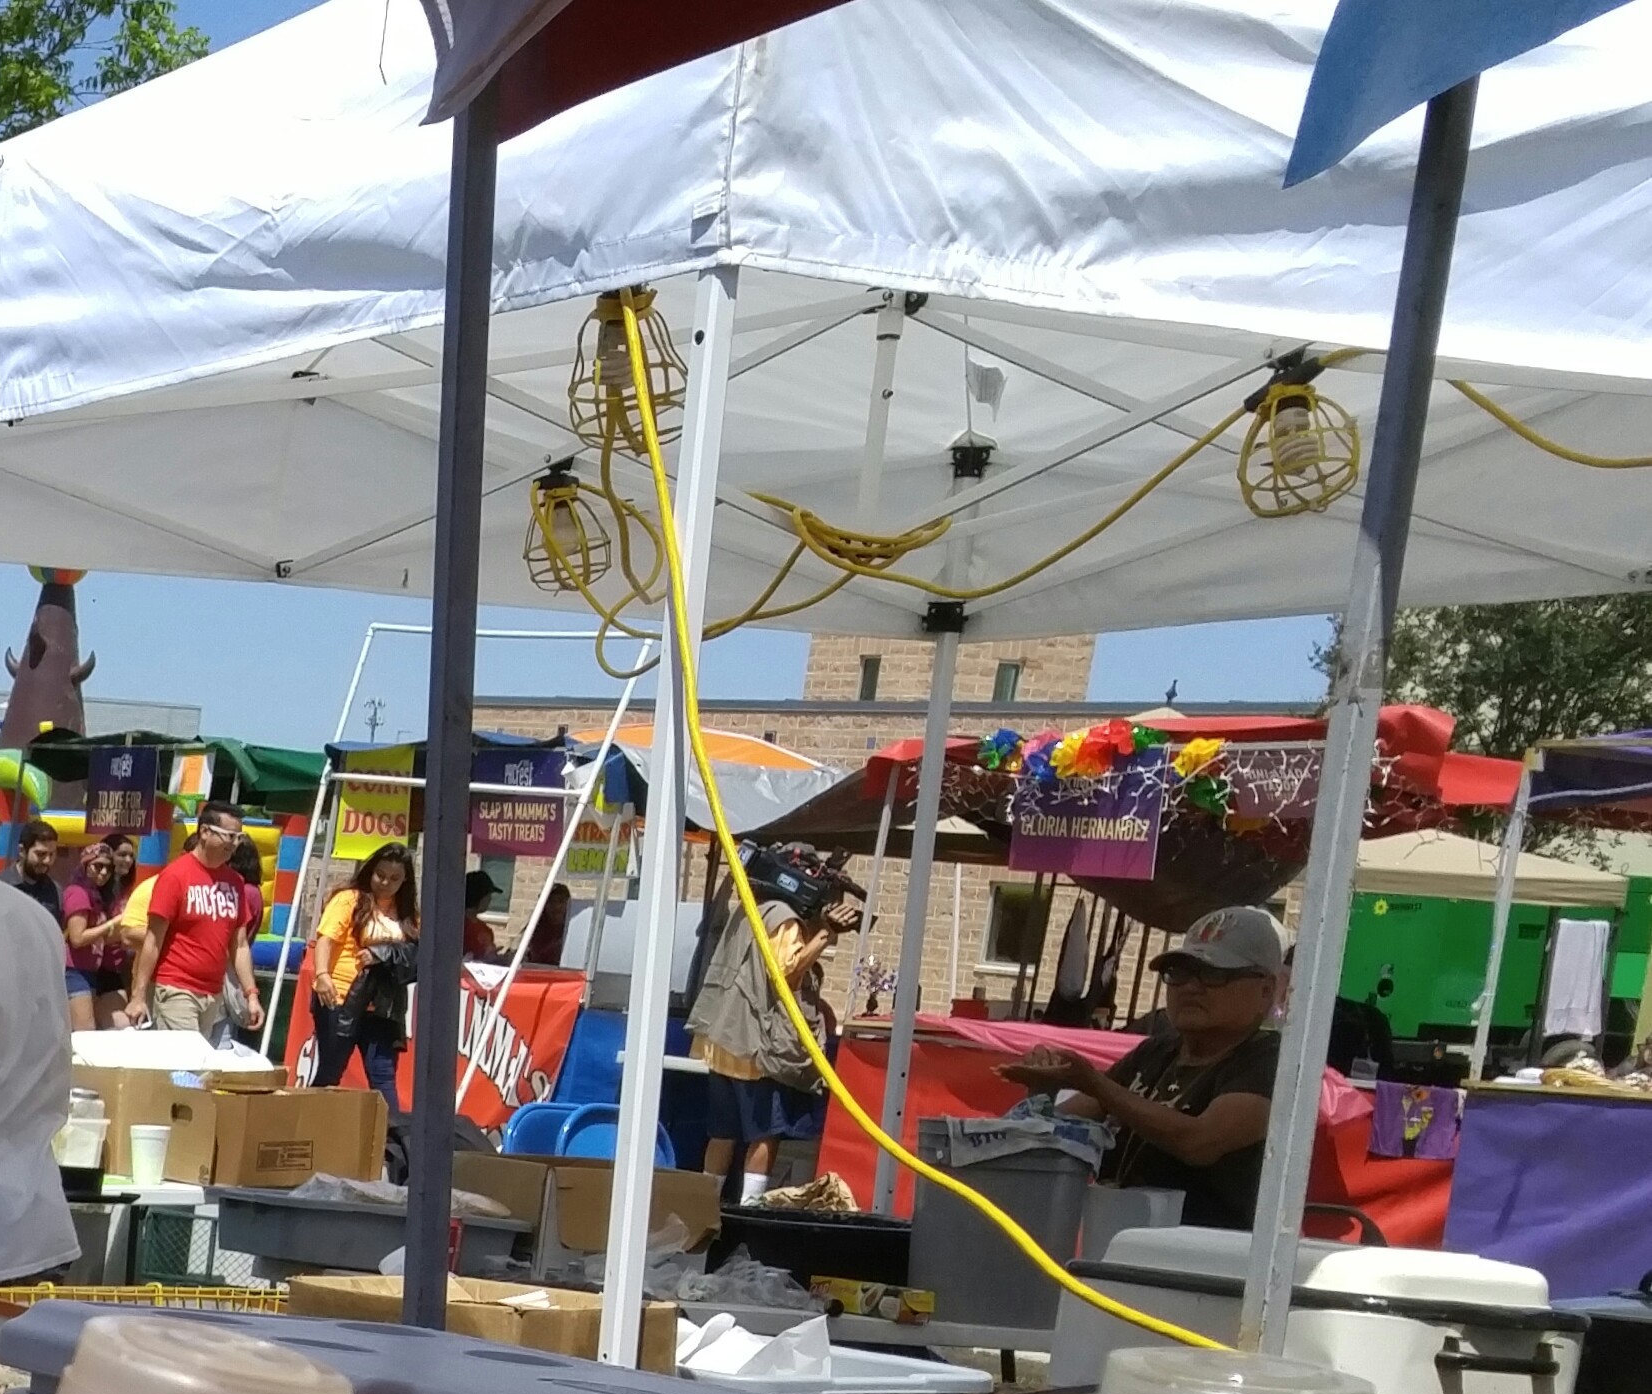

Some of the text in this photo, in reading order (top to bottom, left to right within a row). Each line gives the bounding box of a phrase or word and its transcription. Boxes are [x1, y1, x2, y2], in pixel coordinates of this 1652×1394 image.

[98, 791, 142, 809] TO DYE FOR
[91, 809, 147, 828] COSMETOLOGY
[479, 802, 557, 821] SLAP YA MAMMA'S
[342, 809, 407, 836] DOGS
[1021, 814, 1151, 842] GLORIA HERNANDEZ
[488, 823, 546, 842] TASTY TREATS
